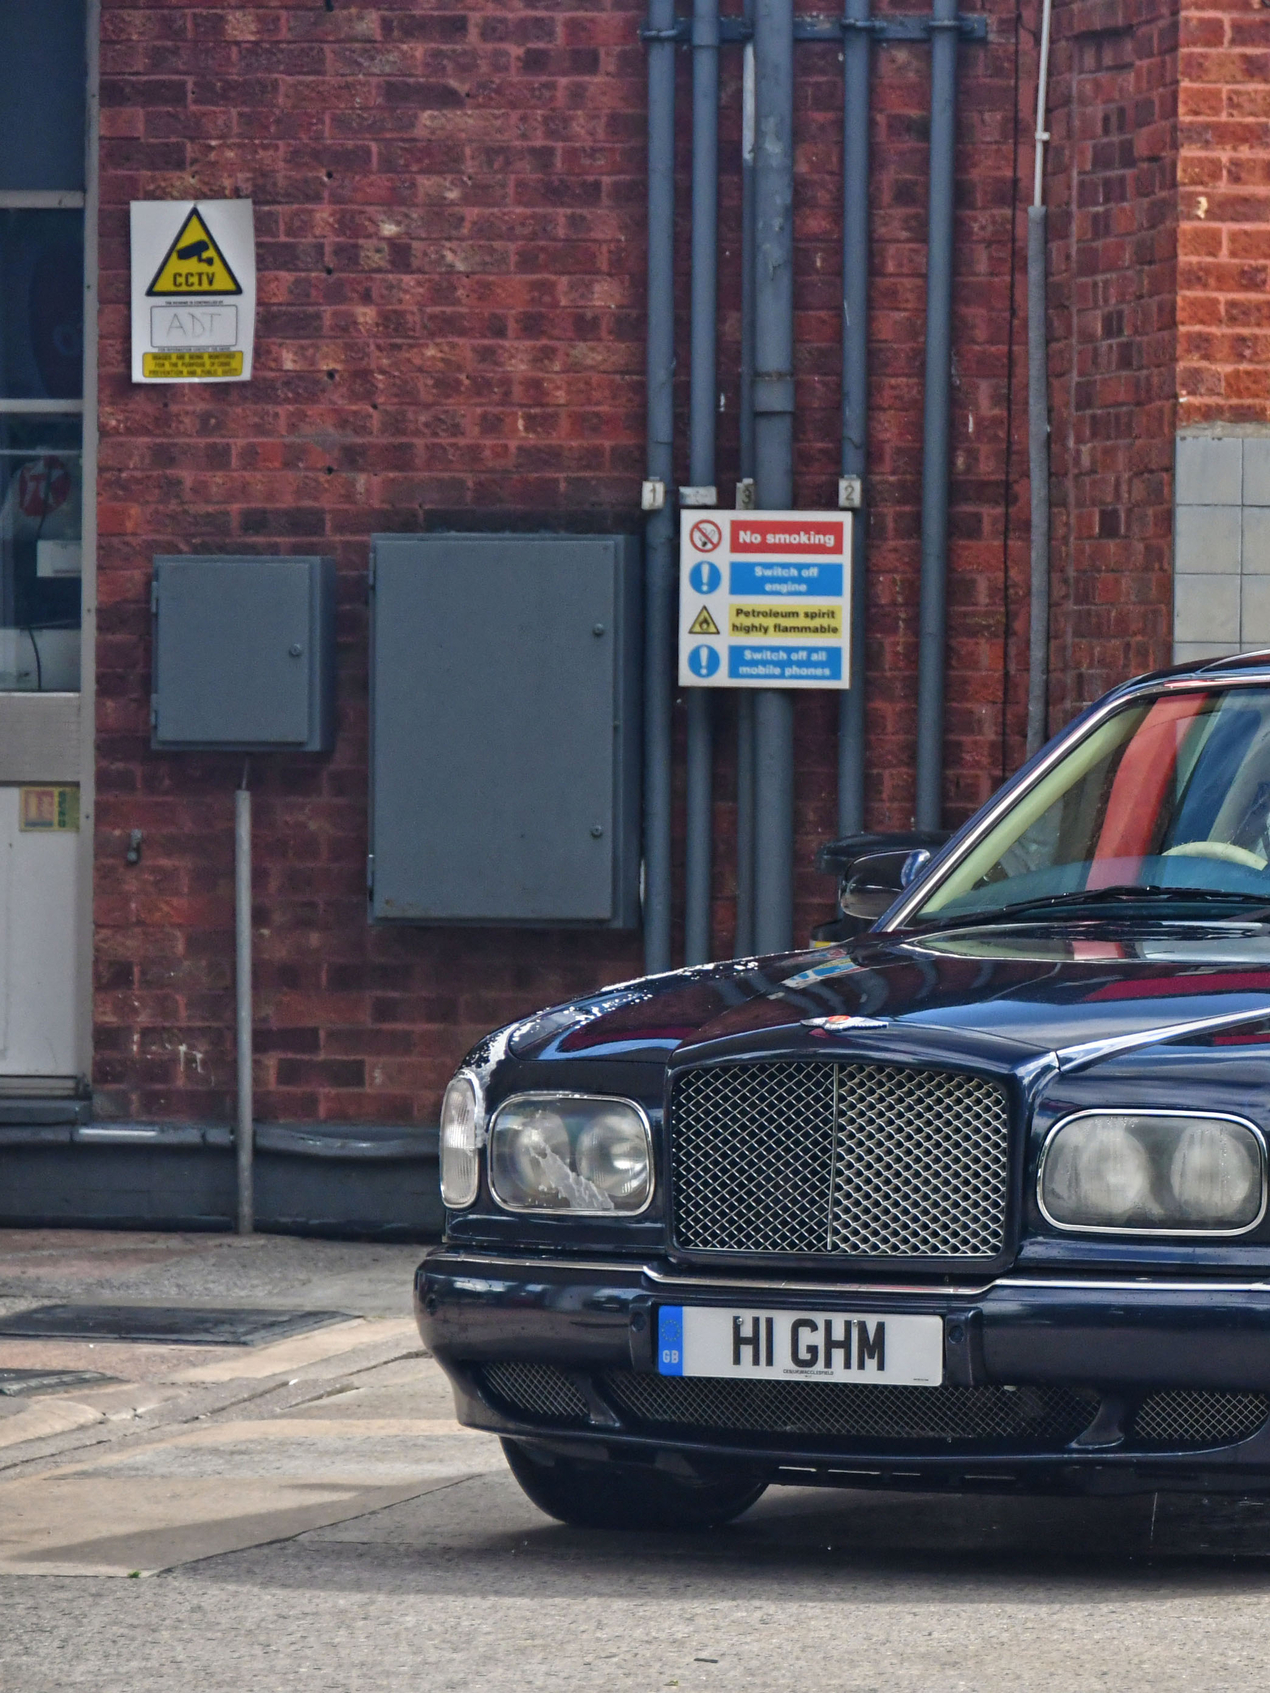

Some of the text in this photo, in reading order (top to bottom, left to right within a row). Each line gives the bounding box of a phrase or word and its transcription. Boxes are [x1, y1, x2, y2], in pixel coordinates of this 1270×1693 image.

[173, 272, 216, 287] CCTV
[166, 312, 221, 337] ADT
[844, 486, 854, 502] 2
[739, 531, 835, 547] No smoking
[755, 566, 819, 577] Switch off
[764, 583, 807, 593] engine
[735, 608, 836, 620] Petroleum spirit
[732, 623, 839, 635] highly flammable
[744, 650, 827, 661] Switch off all
[739, 665, 831, 677] mobile phones
[791, 1318, 885, 1371] GHM
[662, 1350, 679, 1363] GB
